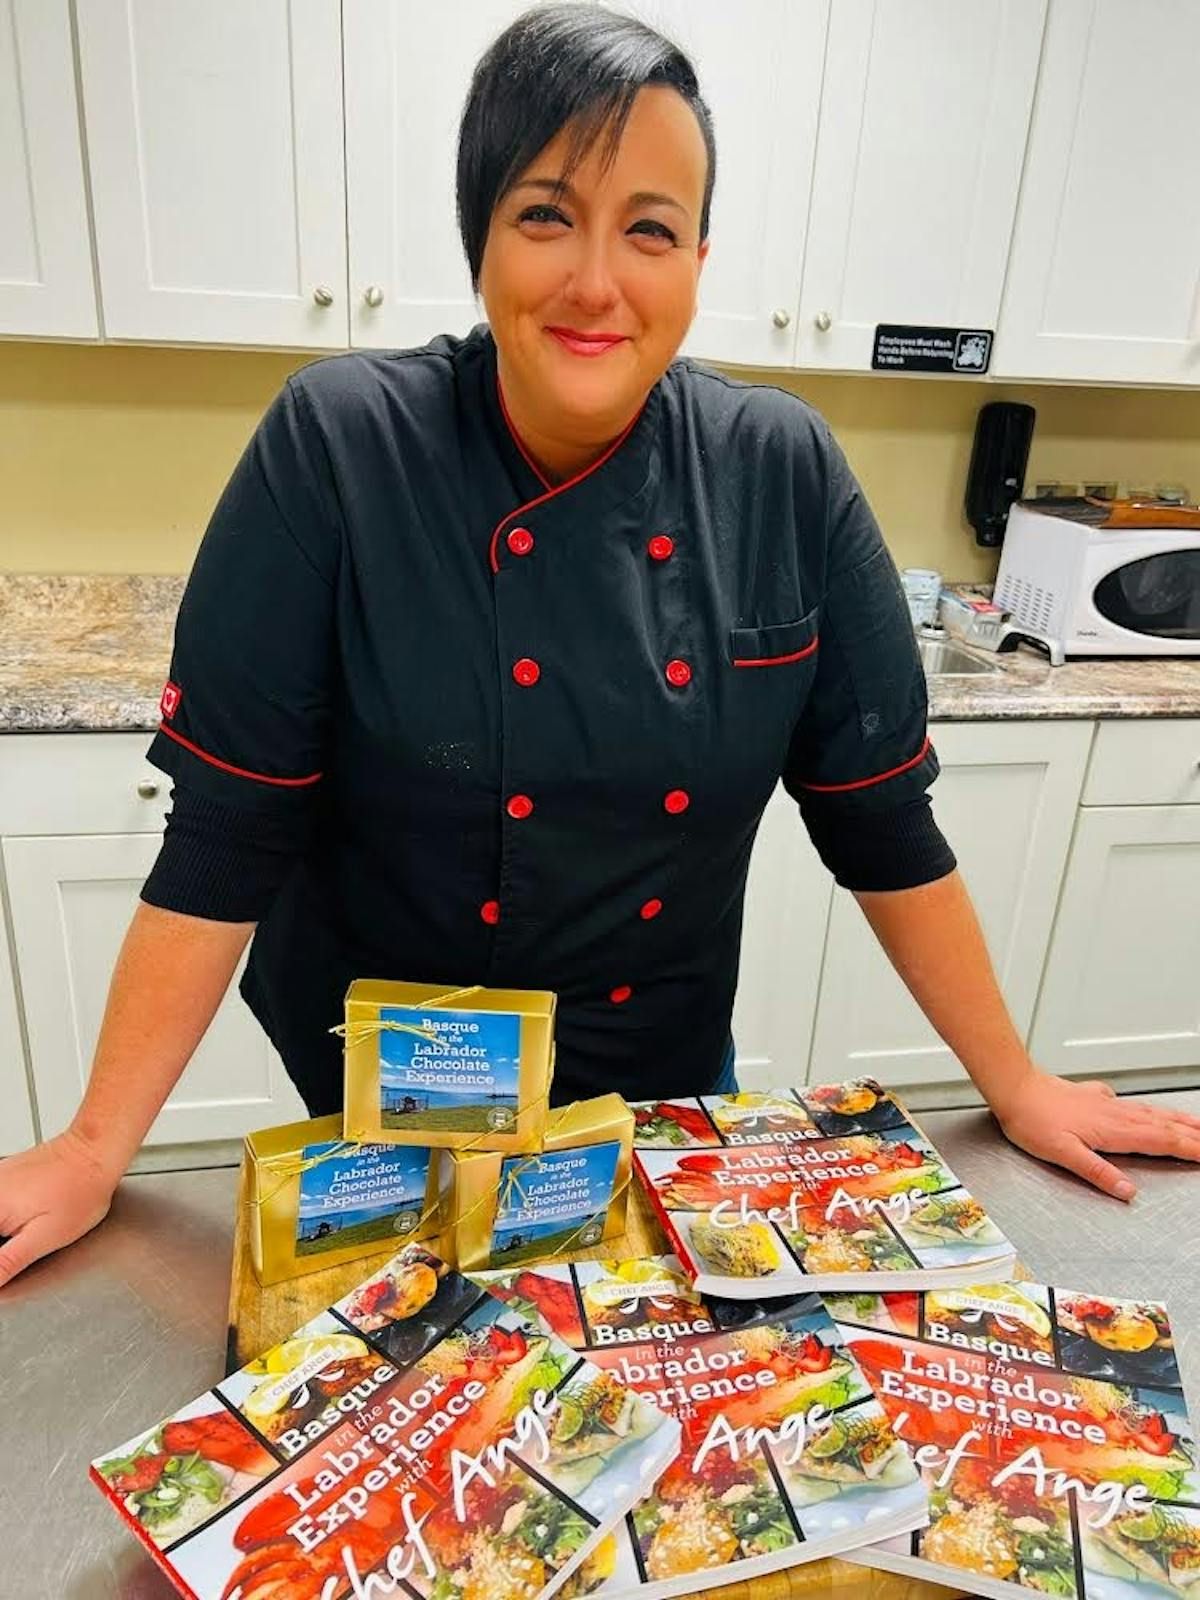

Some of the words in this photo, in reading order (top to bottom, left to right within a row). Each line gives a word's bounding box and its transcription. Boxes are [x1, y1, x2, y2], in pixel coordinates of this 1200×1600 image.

[422, 1018, 480, 1035] Basque
[414, 1043, 487, 1057] Labrador
[411, 1056, 490, 1072] Chocolate
[406, 1070, 495, 1086] Experience
[725, 1128, 821, 1146] Basque
[539, 1158, 588, 1174] Basque
[719, 1146, 853, 1170] Labrador
[333, 1162, 401, 1182] Labrador
[711, 1162, 880, 1188] Experience
[329, 1175, 402, 1195] Chocolate
[528, 1177, 590, 1196] Labrador
[790, 1180, 823, 1192] with
[323, 1186, 405, 1208] Experience
[523, 1189, 590, 1208] Chocolate
[517, 1200, 592, 1221] Experience
[708, 1191, 813, 1232] Chef
[823, 1186, 932, 1224] Ange
[592, 1319, 712, 1345] Basque
[636, 1348, 653, 1360] in
[656, 1343, 685, 1358] the
[928, 1322, 1055, 1367] Basque
[604, 1348, 746, 1384] abrador
[987, 1360, 1017, 1378] the
[638, 1368, 778, 1408] erience
[901, 1350, 1083, 1412] Labrador
[279, 1364, 397, 1456] Basque
[667, 1404, 698, 1420] ith
[880, 1369, 1106, 1444] Experience
[335, 1428, 355, 1448] in
[354, 1404, 384, 1431] the
[971, 1420, 1014, 1439] with
[283, 1374, 447, 1512] Labrador
[691, 1404, 833, 1473] Ange
[286, 1380, 486, 1553] Experience
[394, 1457, 433, 1494] with
[321, 1492, 437, 1600] hef
[451, 1388, 558, 1523] Ange
[991, 1446, 1156, 1528] Ange
